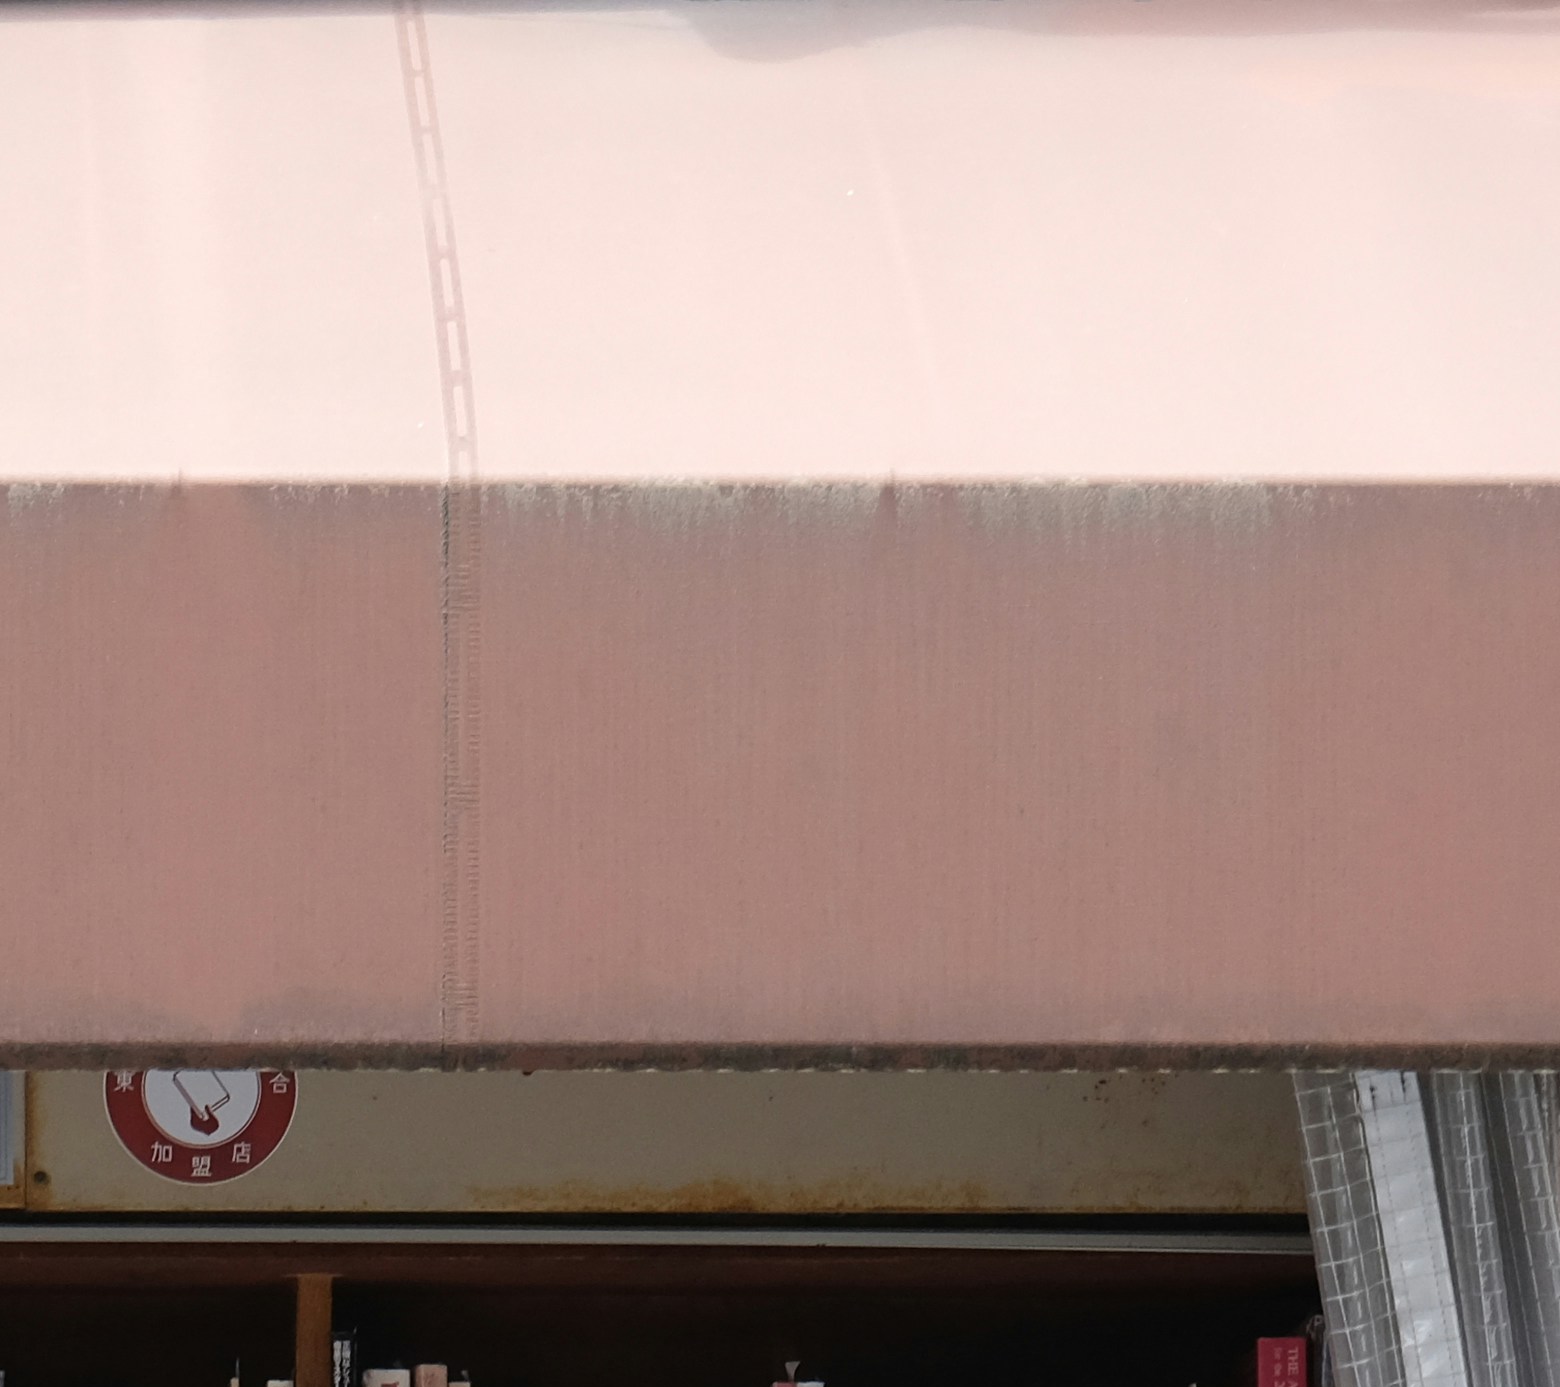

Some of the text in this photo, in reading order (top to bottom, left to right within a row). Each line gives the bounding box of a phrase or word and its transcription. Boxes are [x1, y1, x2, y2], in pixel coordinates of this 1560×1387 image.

[150, 1140, 253, 1178] 加盟店
[1286, 1347, 1299, 1375] THE
